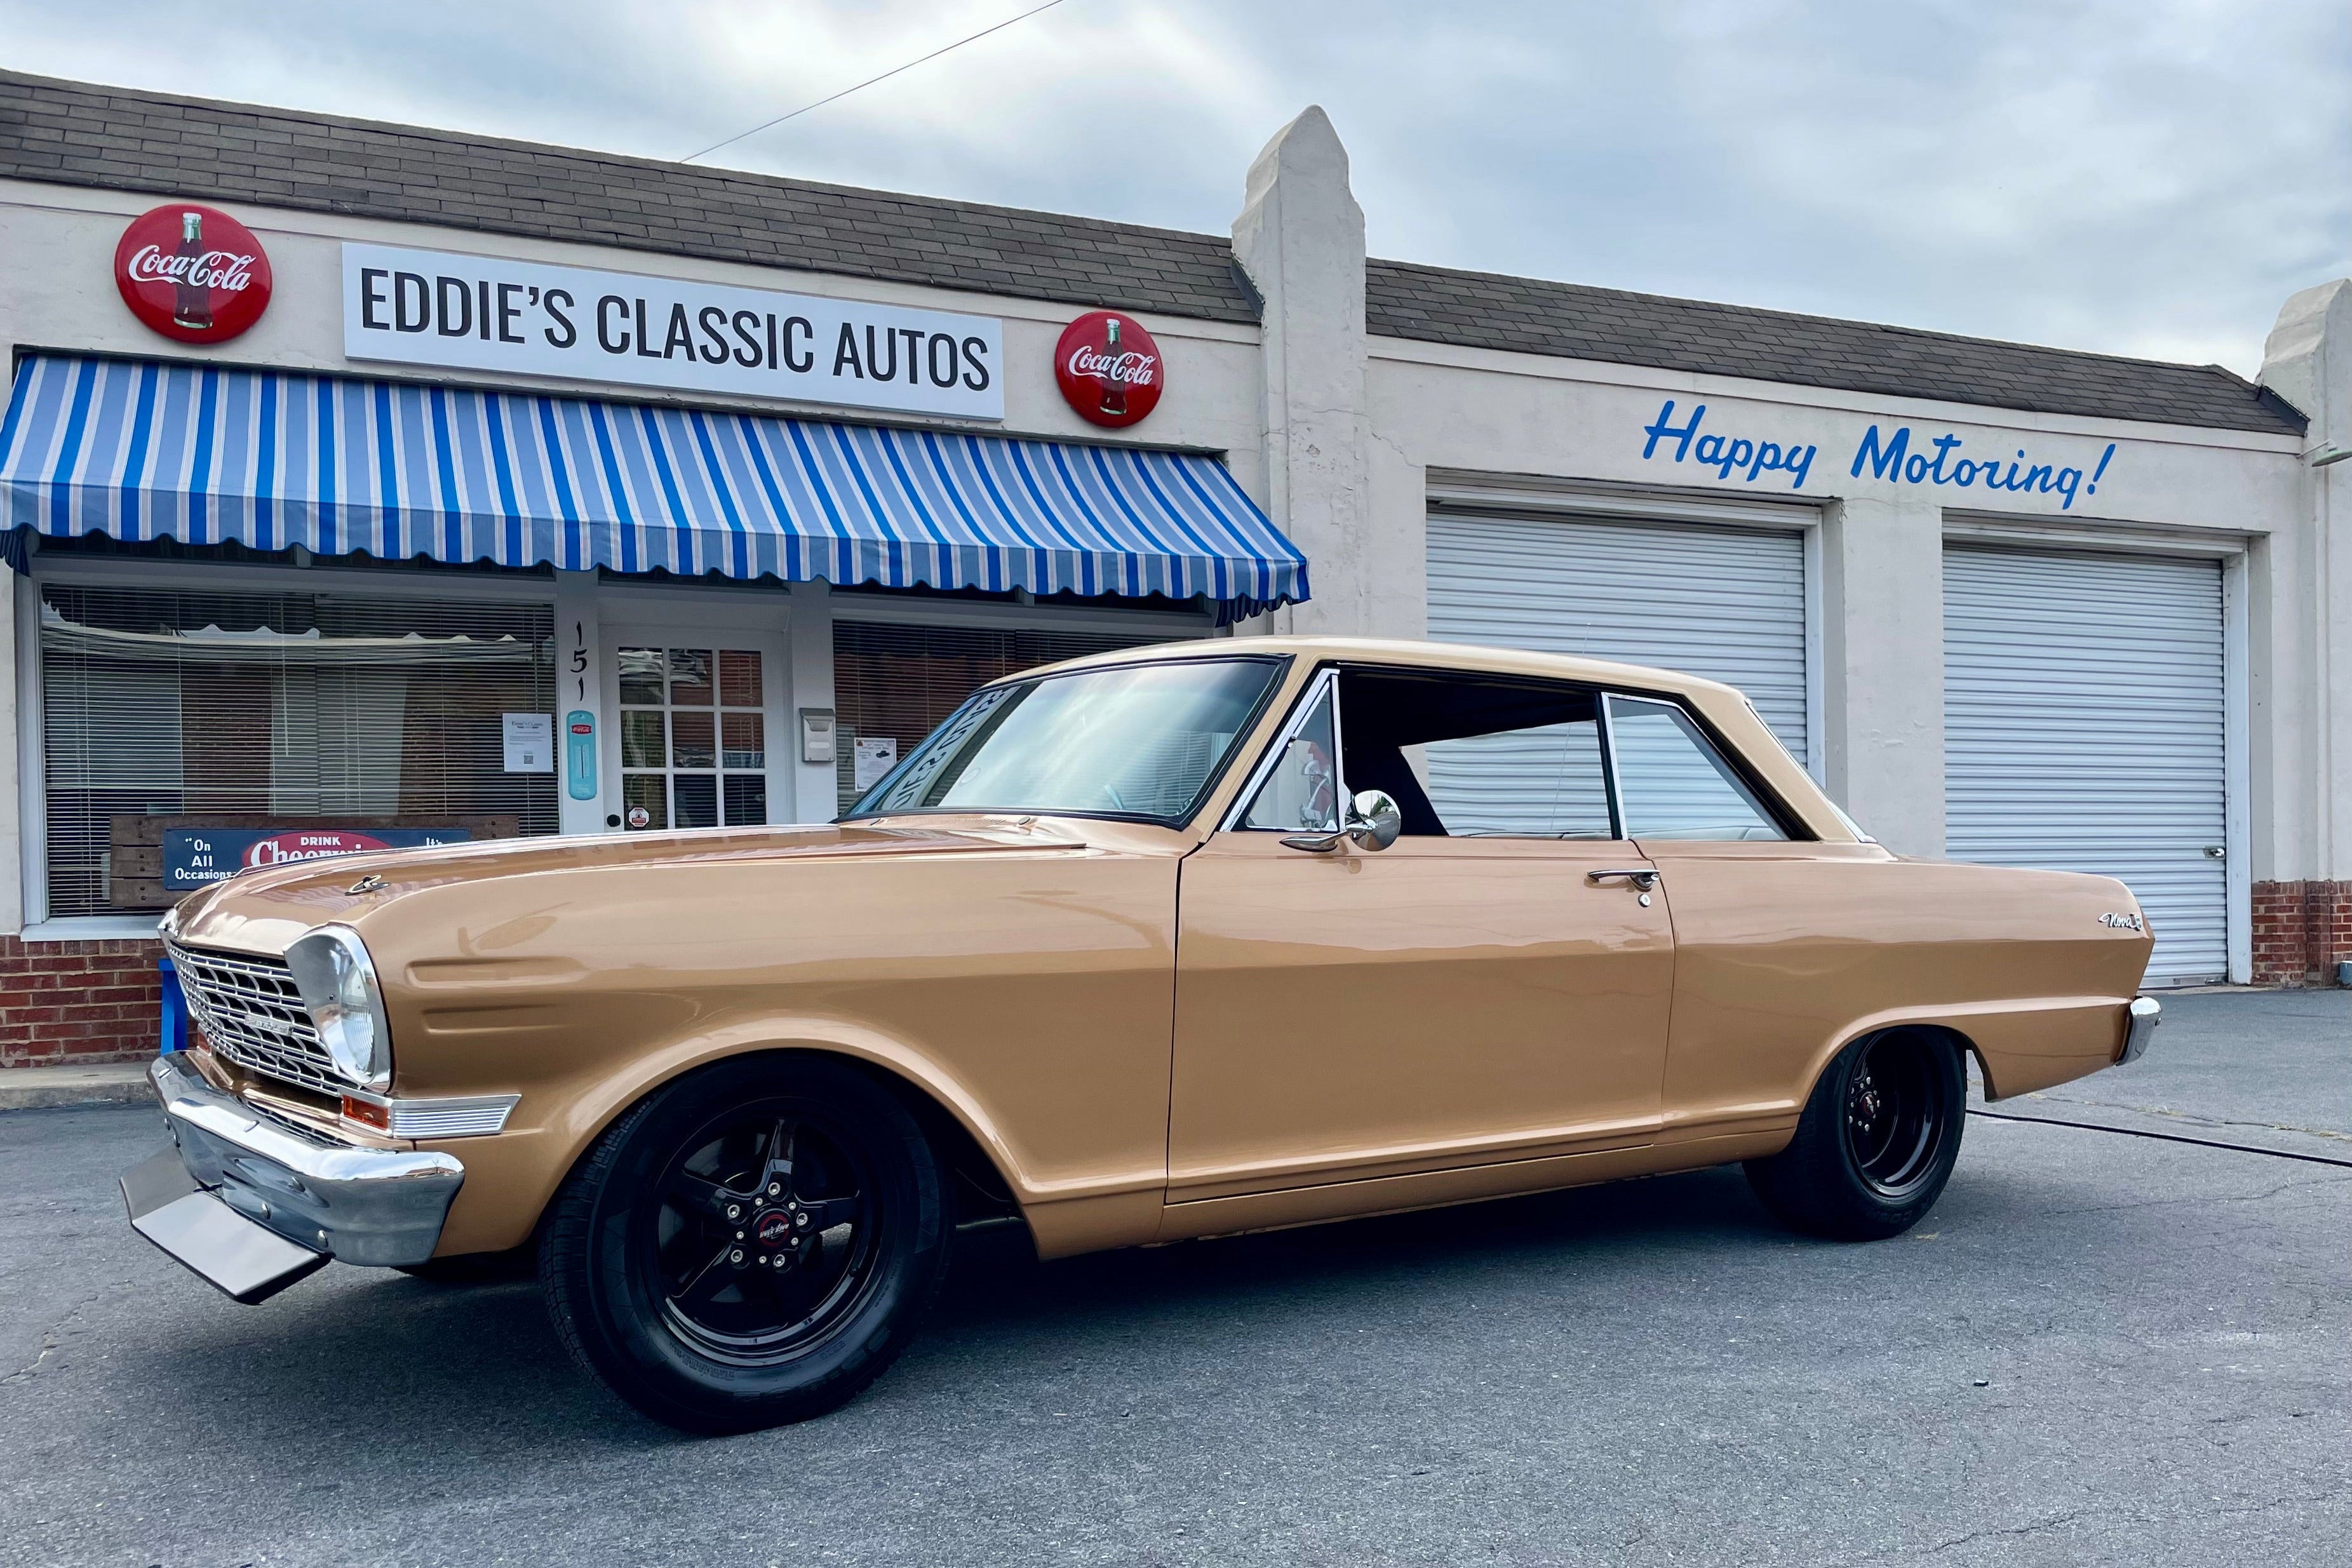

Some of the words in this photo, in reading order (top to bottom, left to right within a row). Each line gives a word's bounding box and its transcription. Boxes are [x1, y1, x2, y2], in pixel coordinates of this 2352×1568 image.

[128, 245, 256, 291] Coca-Cola
[361, 267, 577, 349] EDDIE'S
[597, 295, 814, 373] CLASSIC
[833, 322, 990, 392] AUTOS
[1068, 345, 1155, 385] Coca-Cola
[1643, 399, 1817, 490] Happy
[1850, 424, 2116, 511] Motoring!
[570, 620, 588, 702] 151
[191, 855, 213, 867] All
[300, 836, 341, 846] DRINK
[2098, 913, 2137, 928] Nova
